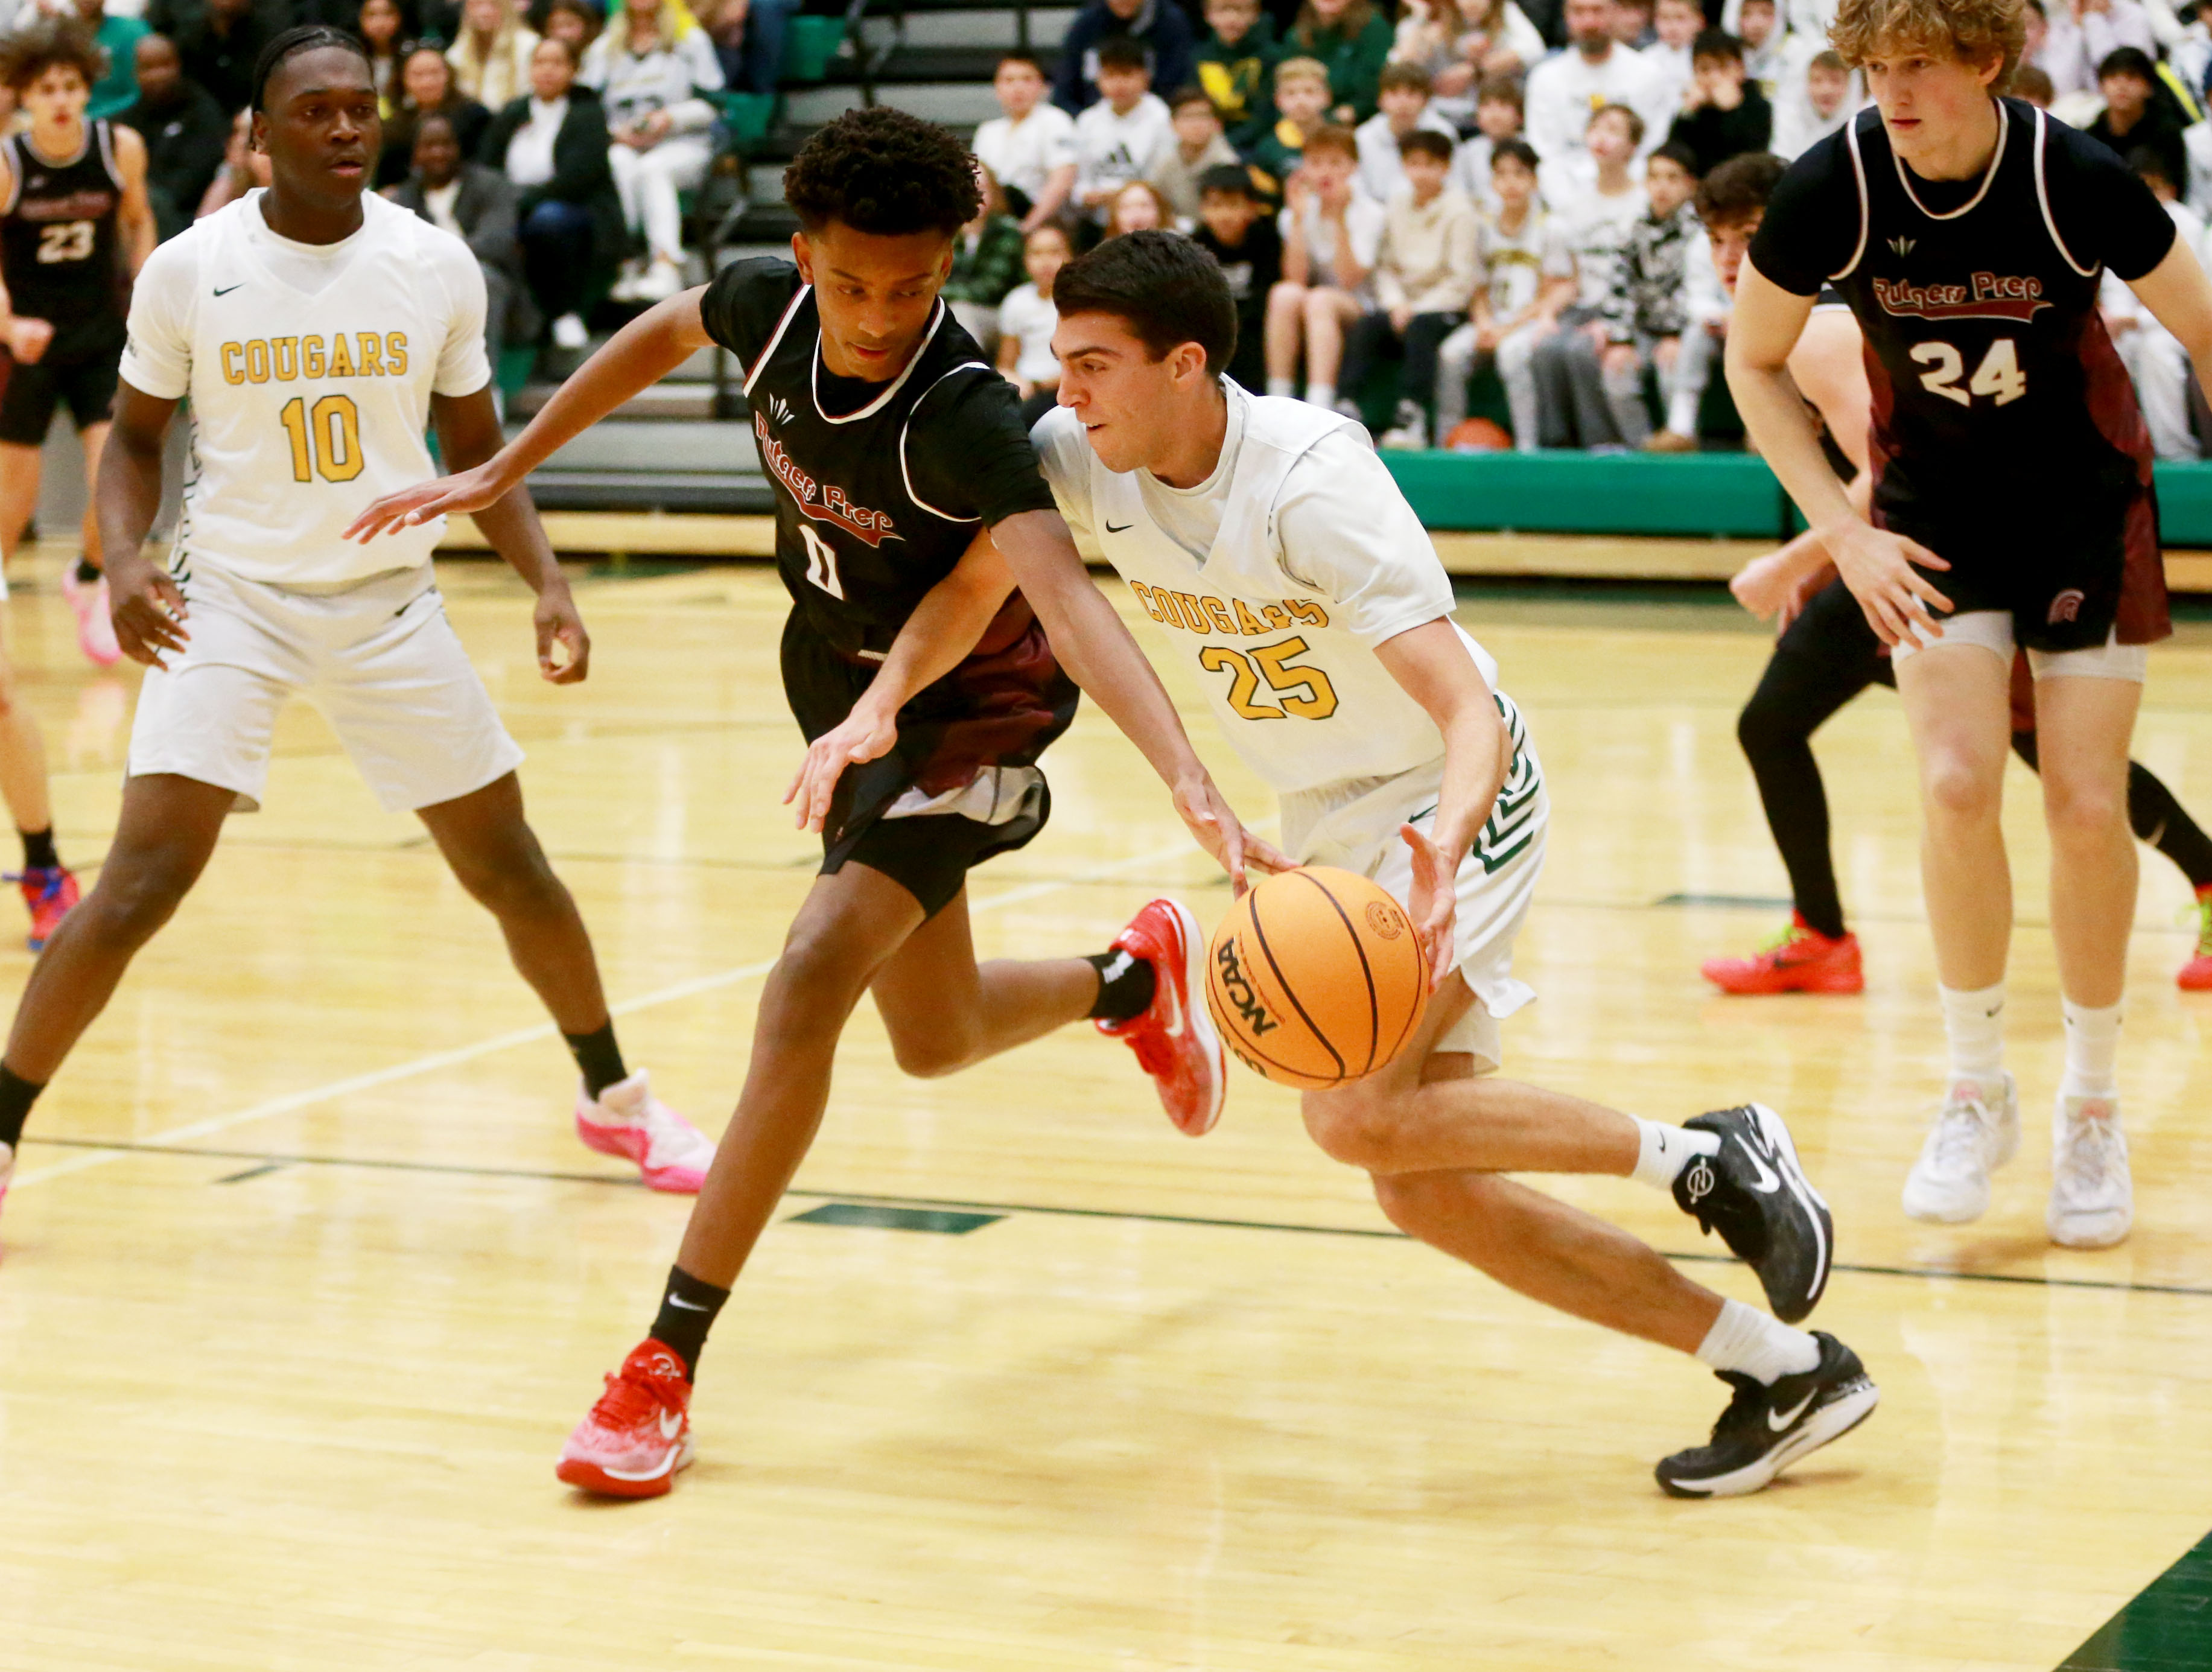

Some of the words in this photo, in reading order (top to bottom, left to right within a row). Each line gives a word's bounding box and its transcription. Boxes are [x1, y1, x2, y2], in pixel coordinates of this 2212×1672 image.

[37, 220, 95, 264] 23
[1872, 277, 1968, 311] Rutgers
[1971, 270, 2042, 302] Prep
[219, 331, 408, 386] COUGARS
[1908, 339, 2027, 408] 24
[281, 394, 365, 483] 10
[822, 485, 894, 531] Prep
[797, 523, 845, 601] 0
[1198, 635, 1340, 720] 25
[1217, 936, 1279, 1037] NCAA
